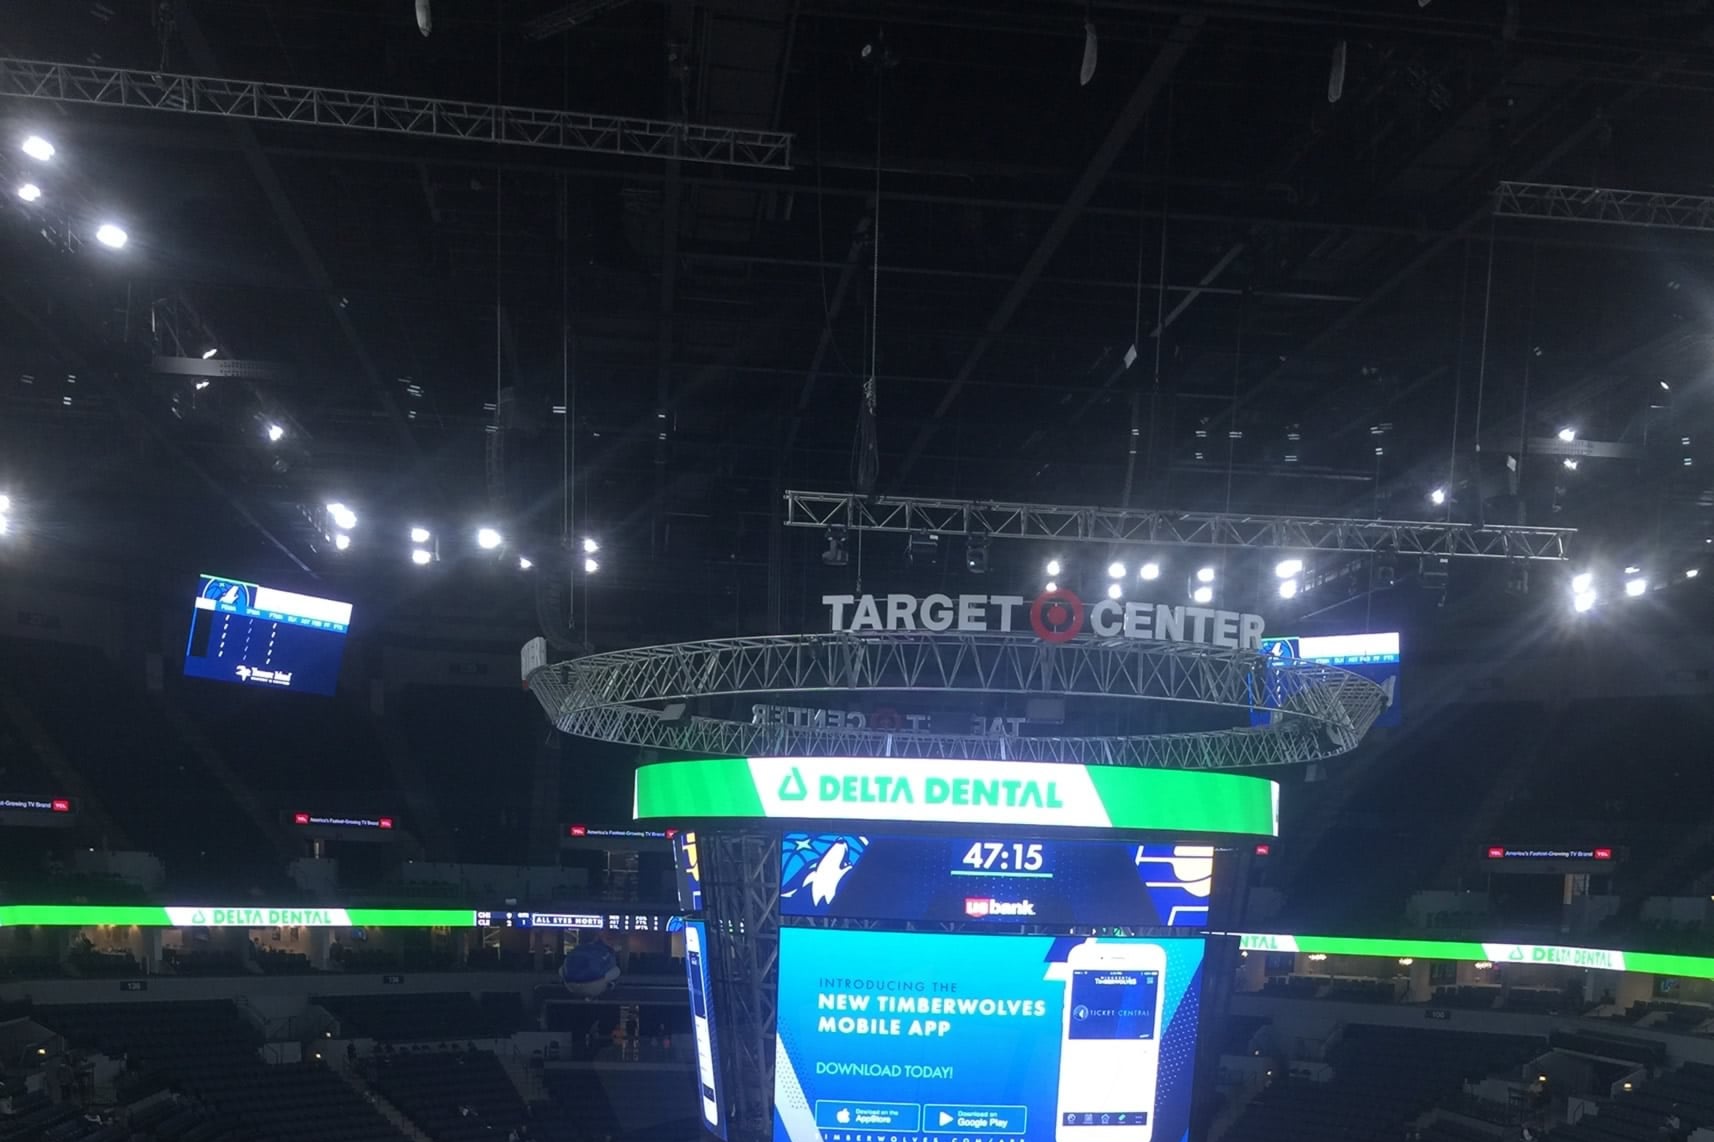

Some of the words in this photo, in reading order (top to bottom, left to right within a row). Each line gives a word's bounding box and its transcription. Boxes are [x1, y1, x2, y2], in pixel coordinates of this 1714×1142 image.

[822, 594, 1023, 633] TARGET
[1090, 599, 1265, 650] CENTER
[820, 775, 914, 804] DELTA
[925, 777, 1063, 808] DENTAL
[962, 842, 1043, 871] 47:15
[213, 909, 263, 924] DELTA
[268, 910, 332, 924] DENTAL
[1533, 947, 1571, 961] DELTA
[1574, 949, 1612, 967] DENTAL
[819, 977, 925, 992] INTRODUCING
[932, 981, 957, 993] THE
[818, 993, 870, 1011] NEW
[877, 996, 1046, 1017] TIMBERWOLVES
[818, 1016, 901, 1035] MOBILE
[908, 1020, 952, 1037] APP
[816, 1062, 901, 1077] DOWNLOAD
[905, 1065, 953, 1079] TODAY!
[957, 1118, 988, 1128] Google
[989, 1118, 1008, 1128] Play
